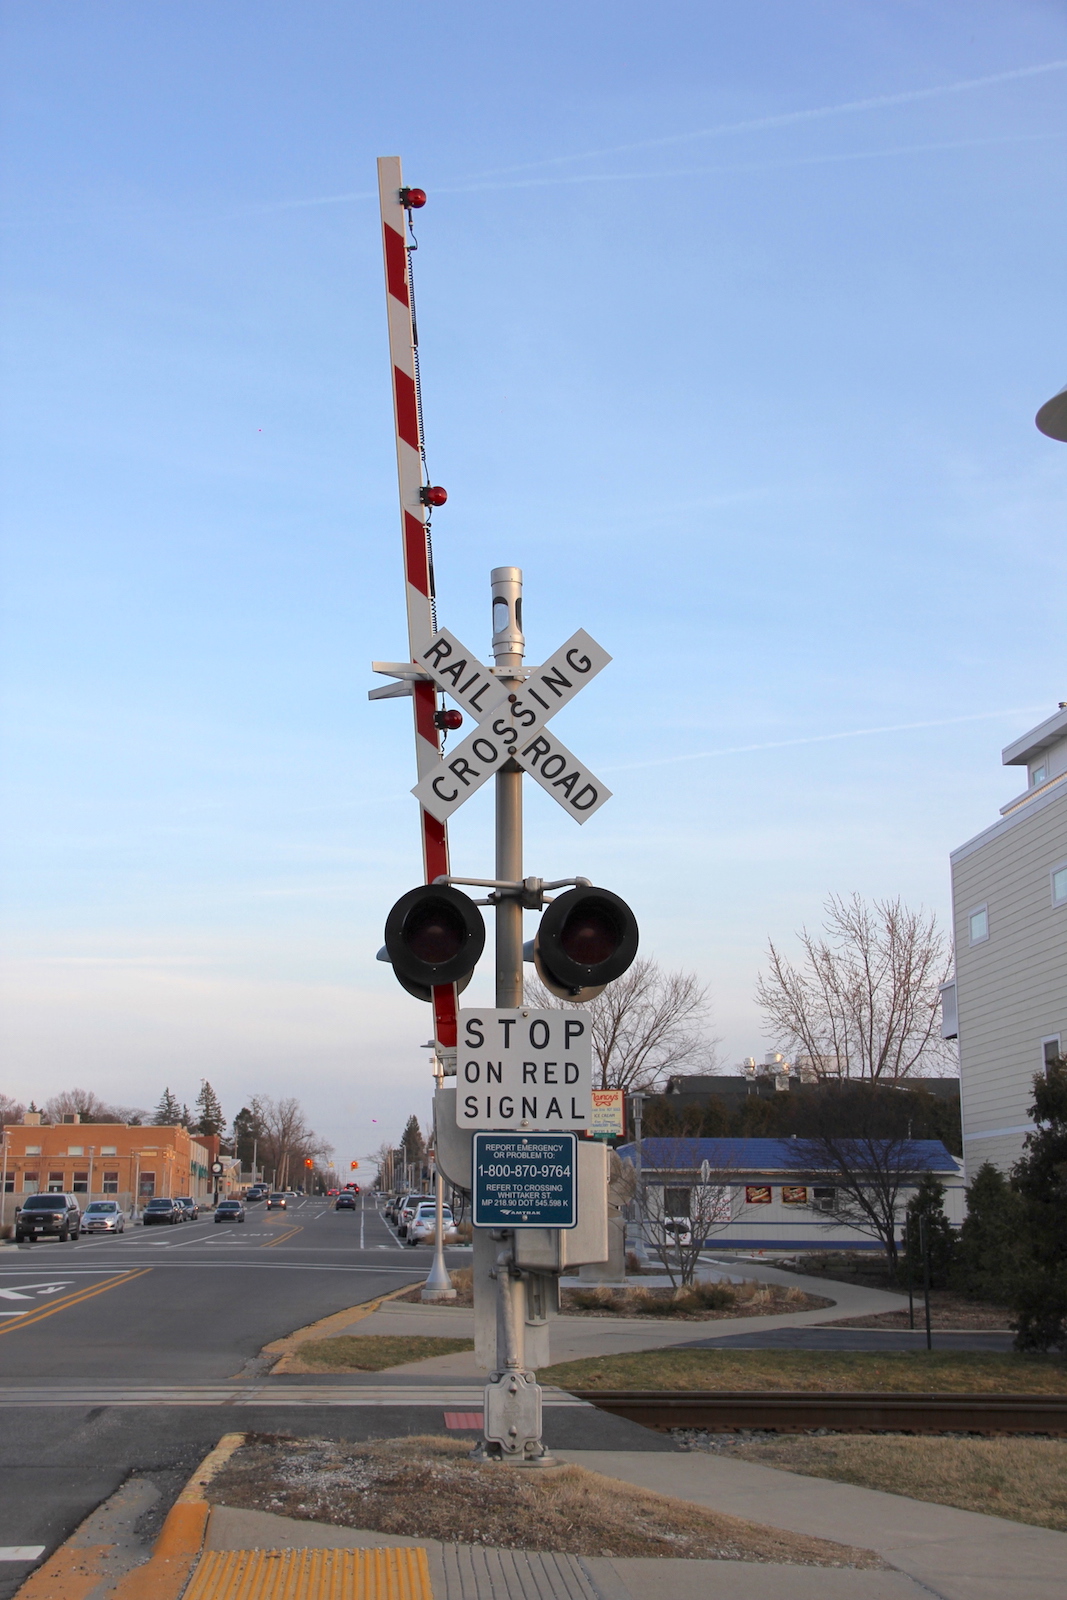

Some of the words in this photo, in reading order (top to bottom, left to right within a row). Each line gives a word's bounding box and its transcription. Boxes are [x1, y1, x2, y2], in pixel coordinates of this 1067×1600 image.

[423, 637, 491, 713] RAIL
[521, 735, 598, 811] ROAD
[432, 648, 592, 802] CROSSING
[464, 1018, 585, 1049] STOP
[464, 1061, 502, 1083] ON
[522, 1062, 580, 1084] RED
[464, 1096, 585, 1119] SIGNAL
[516, 1144, 563, 1152] EMERGENCY
[493, 1151, 505, 1159] OR
[506, 1151, 542, 1159] PROBLEM
[543, 1152, 556, 1160] TO:
[478, 1164, 571, 1177] 1-800-870-9764
[523, 1184, 563, 1192] CROSSING
[497, 1191, 540, 1199] WHITTAKER
[494, 1199, 517, 1207] 218.90
[518, 1199, 534, 1207] DOT
